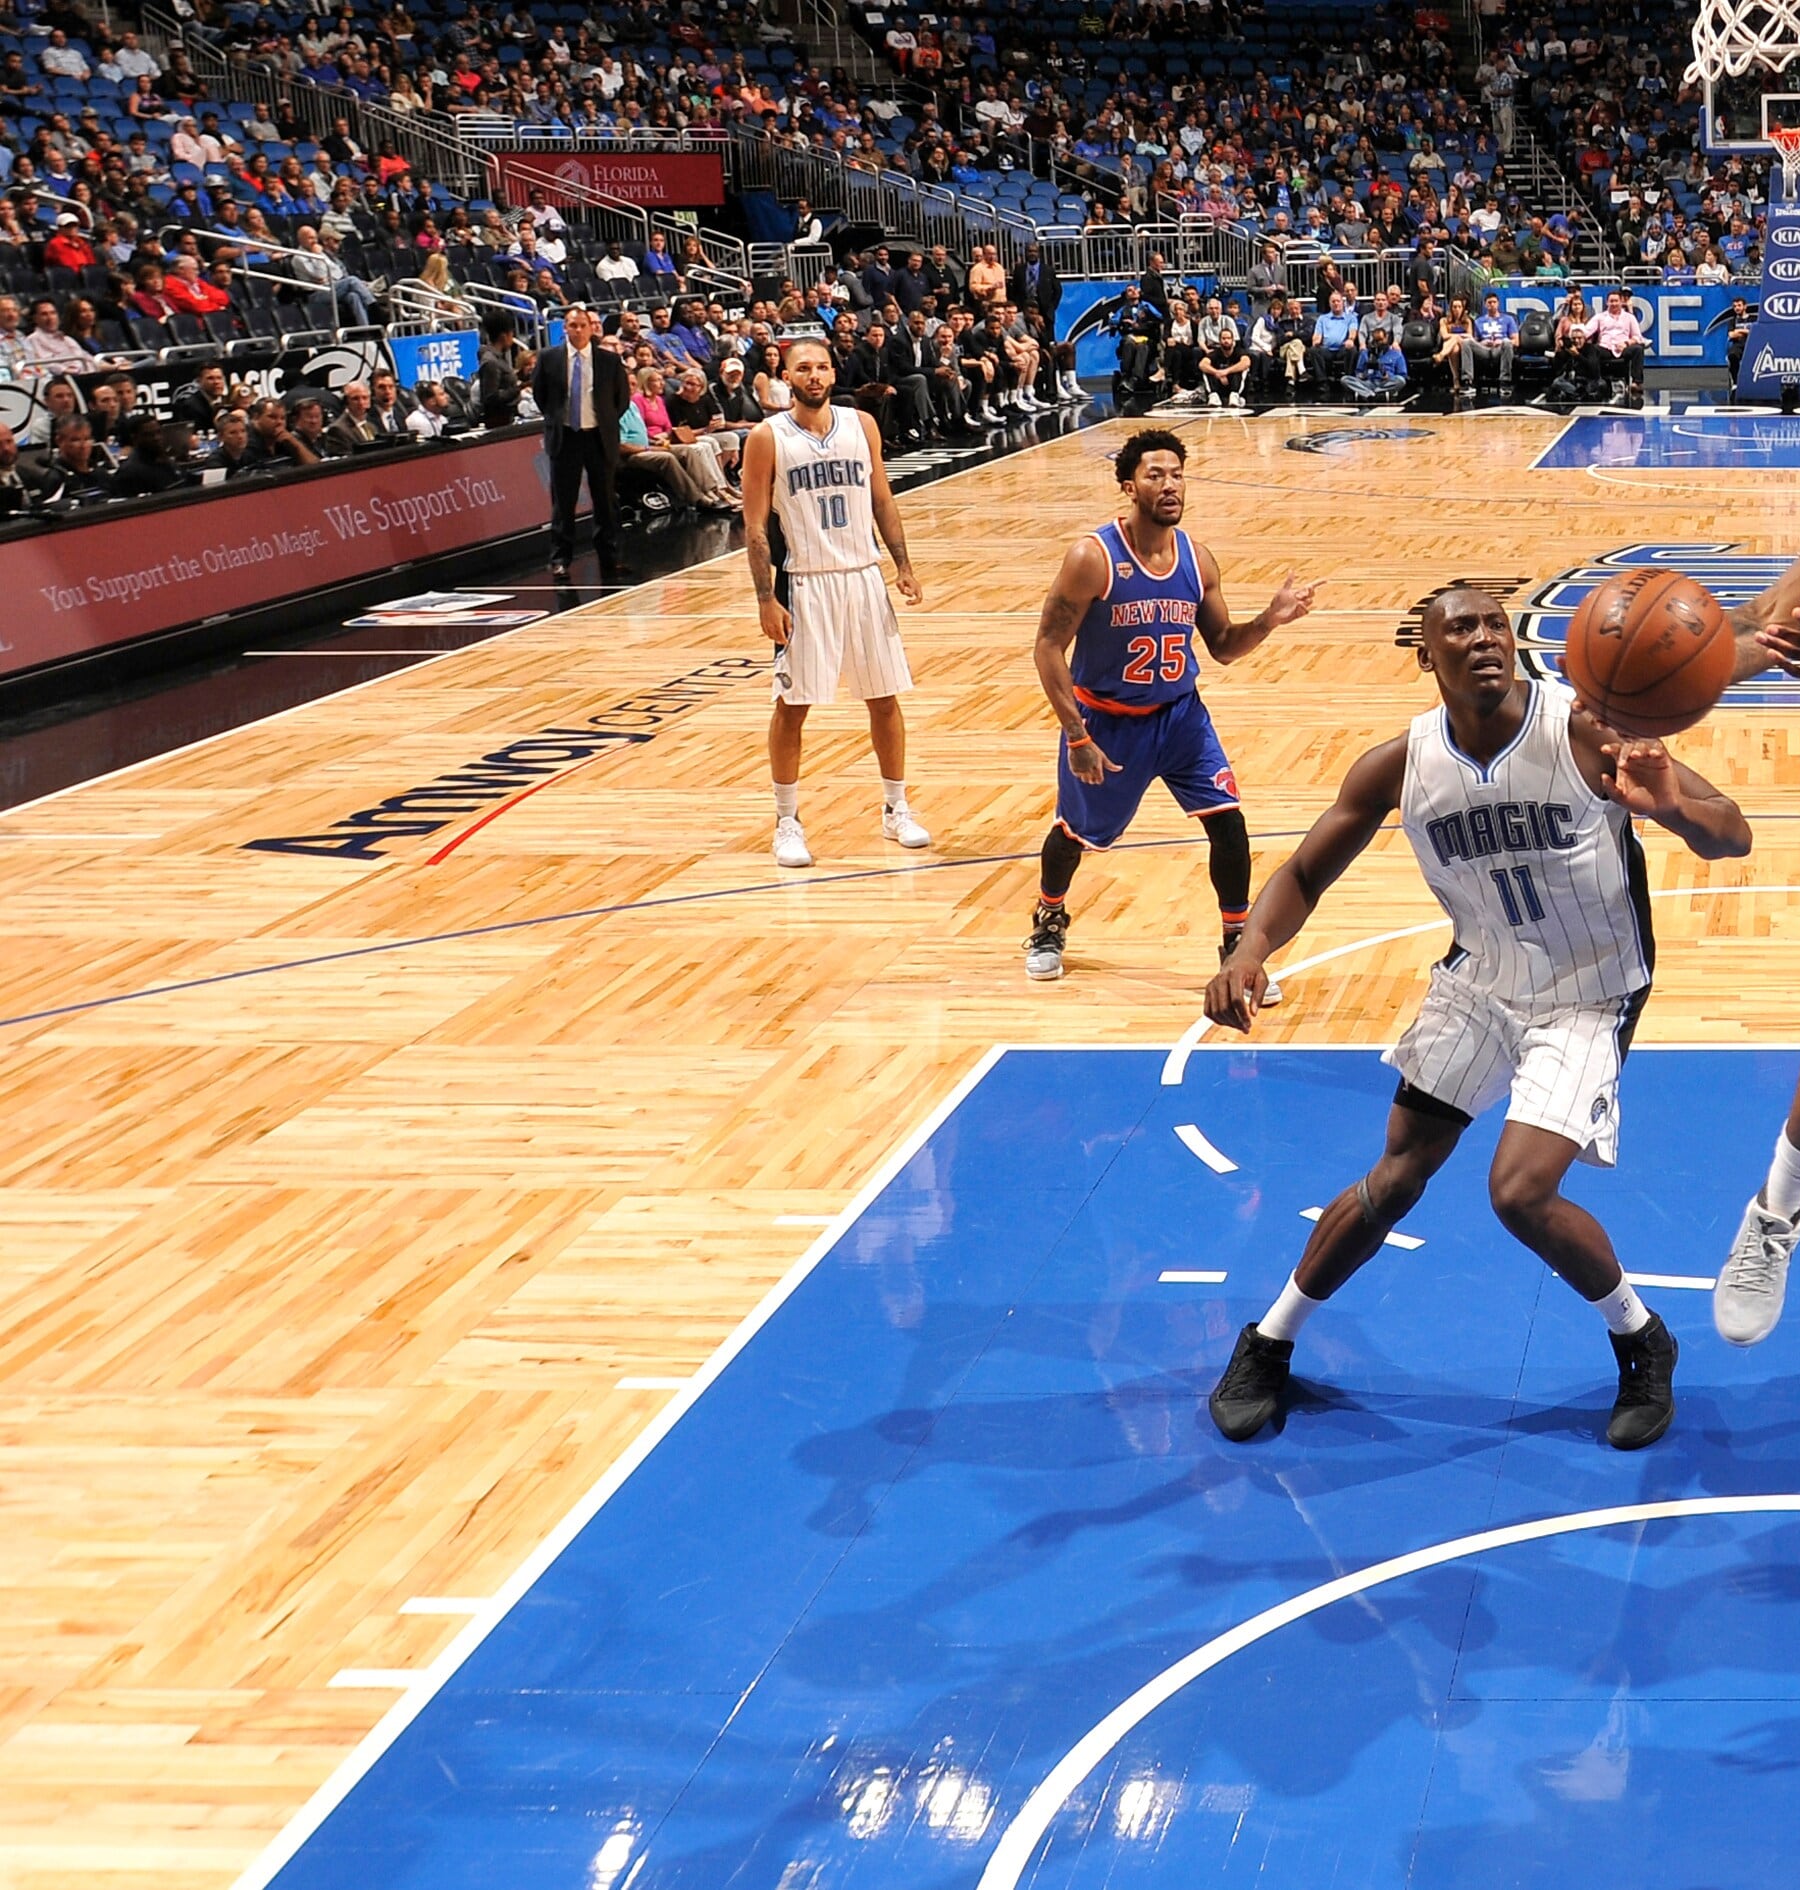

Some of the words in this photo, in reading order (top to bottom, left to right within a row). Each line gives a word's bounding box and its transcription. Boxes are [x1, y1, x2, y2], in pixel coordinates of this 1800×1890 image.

[594, 165, 658, 181] FLORIDA
[595, 183, 667, 199] HOSPITAL
[786, 459, 866, 497] MAGIC
[817, 493, 849, 530] 10
[40, 585, 87, 611] You
[87, 566, 169, 603] Support
[169, 555, 202, 583] the
[202, 536, 274, 574] Orlando
[273, 526, 329, 557] Magic.
[323, 502, 371, 541] We
[370, 483, 459, 535] Support
[456, 475, 506, 509] You.
[1110, 600, 1156, 627] NEW
[1122, 633, 1187, 684] 25
[240, 728, 657, 861] Amway
[588, 656, 776, 728] CENTER
[1425, 801, 1579, 867] MAGIC
[1489, 865, 1546, 926] 11
